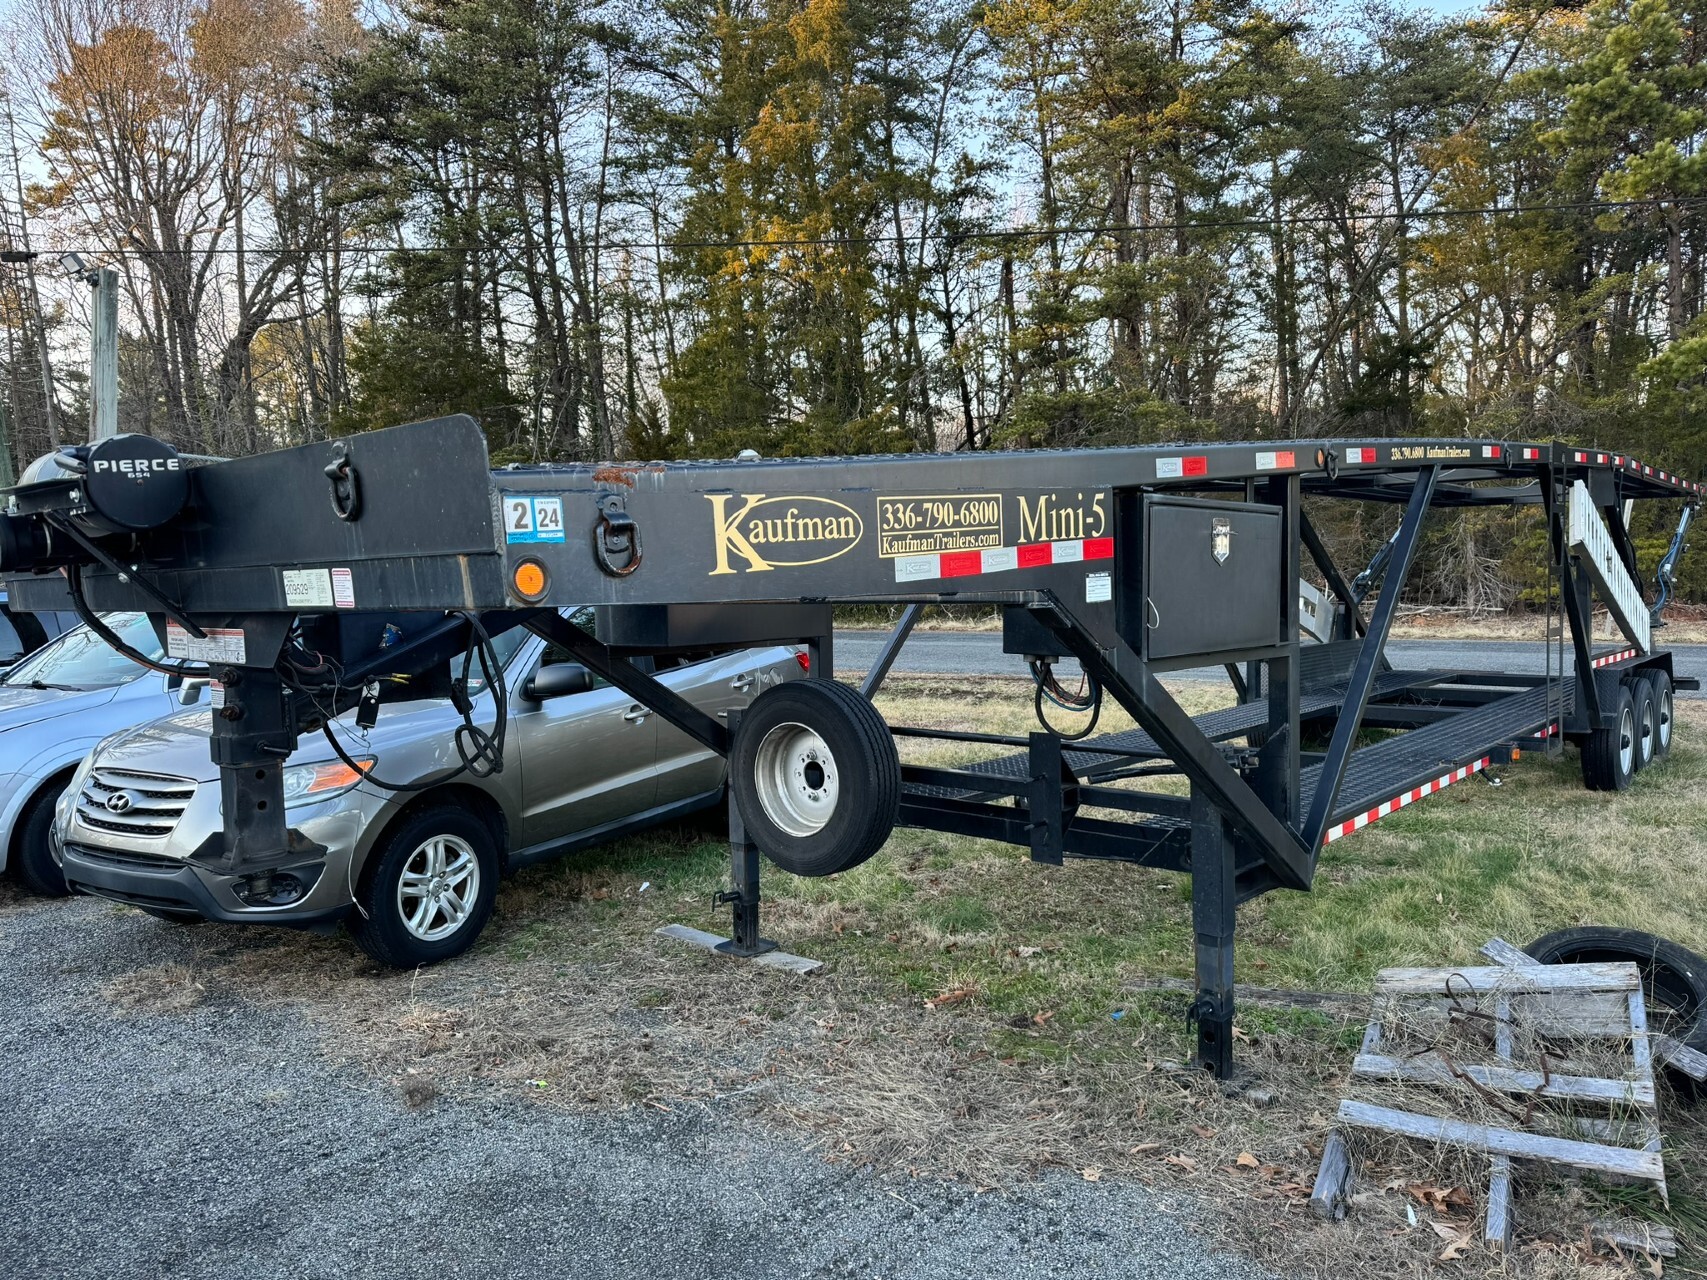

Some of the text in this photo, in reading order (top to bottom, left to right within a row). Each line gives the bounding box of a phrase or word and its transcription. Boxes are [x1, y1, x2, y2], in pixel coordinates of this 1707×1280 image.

[93, 459, 179, 473] PIERCE
[512, 502, 529, 530] 2
[538, 508, 560, 528] 24
[882, 500, 998, 530] 336-790-6800
[1016, 492, 1105, 543] Mini-5
[704, 494, 856, 575] Kaufman
[882, 532, 999, 554] KaufmanTrailers.com
